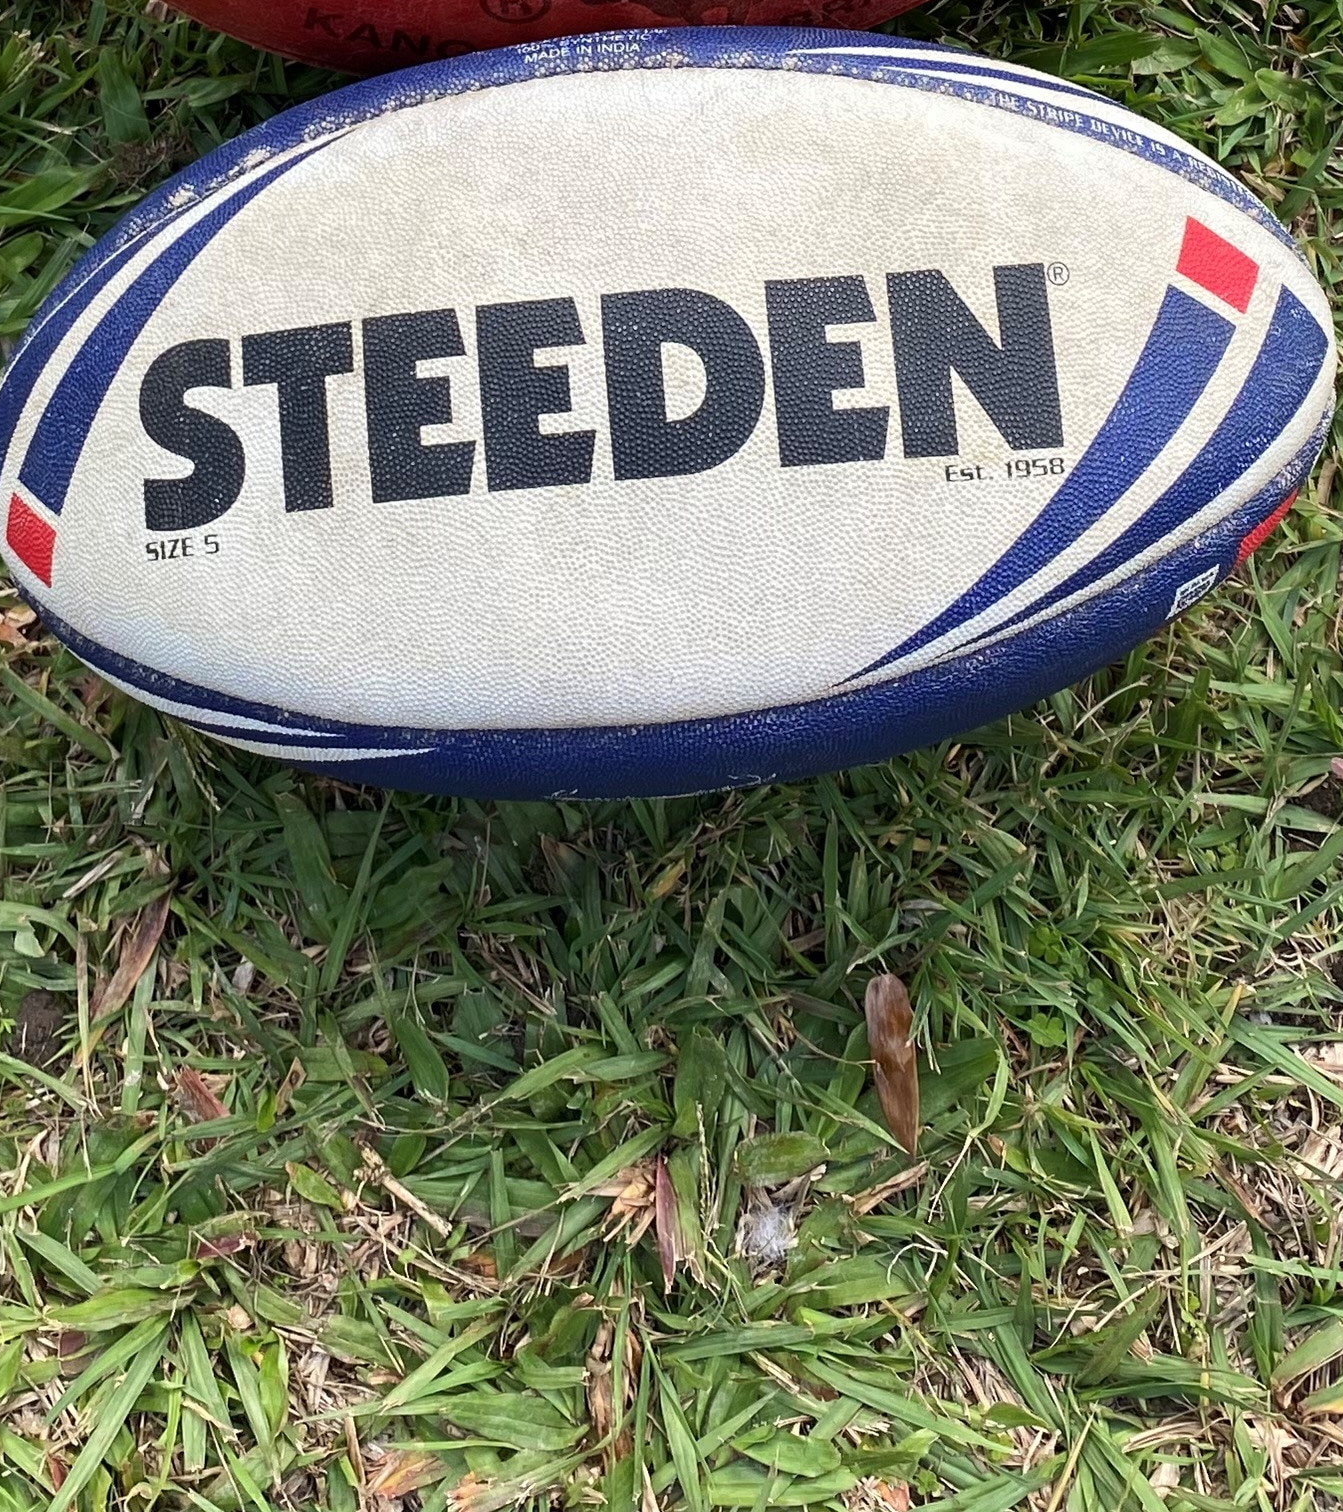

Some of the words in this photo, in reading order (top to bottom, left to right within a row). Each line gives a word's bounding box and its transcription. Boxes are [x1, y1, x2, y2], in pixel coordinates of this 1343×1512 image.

[524, 47, 571, 64] MADE
[576, 44, 592, 55] IN
[596, 41, 641, 54] INDIA
[1026, 101, 1085, 128] STRIPE
[1090, 119, 1145, 148] DEVICE
[1150, 138, 1166, 156] IS
[1172, 149, 1183, 161] A
[139, 262, 1065, 532] STEEDEN
[945, 464, 994, 483] Est.
[1006, 457, 1066, 479] 1958
[145, 536, 194, 562] SIZE
[203, 533, 220, 555] 5
